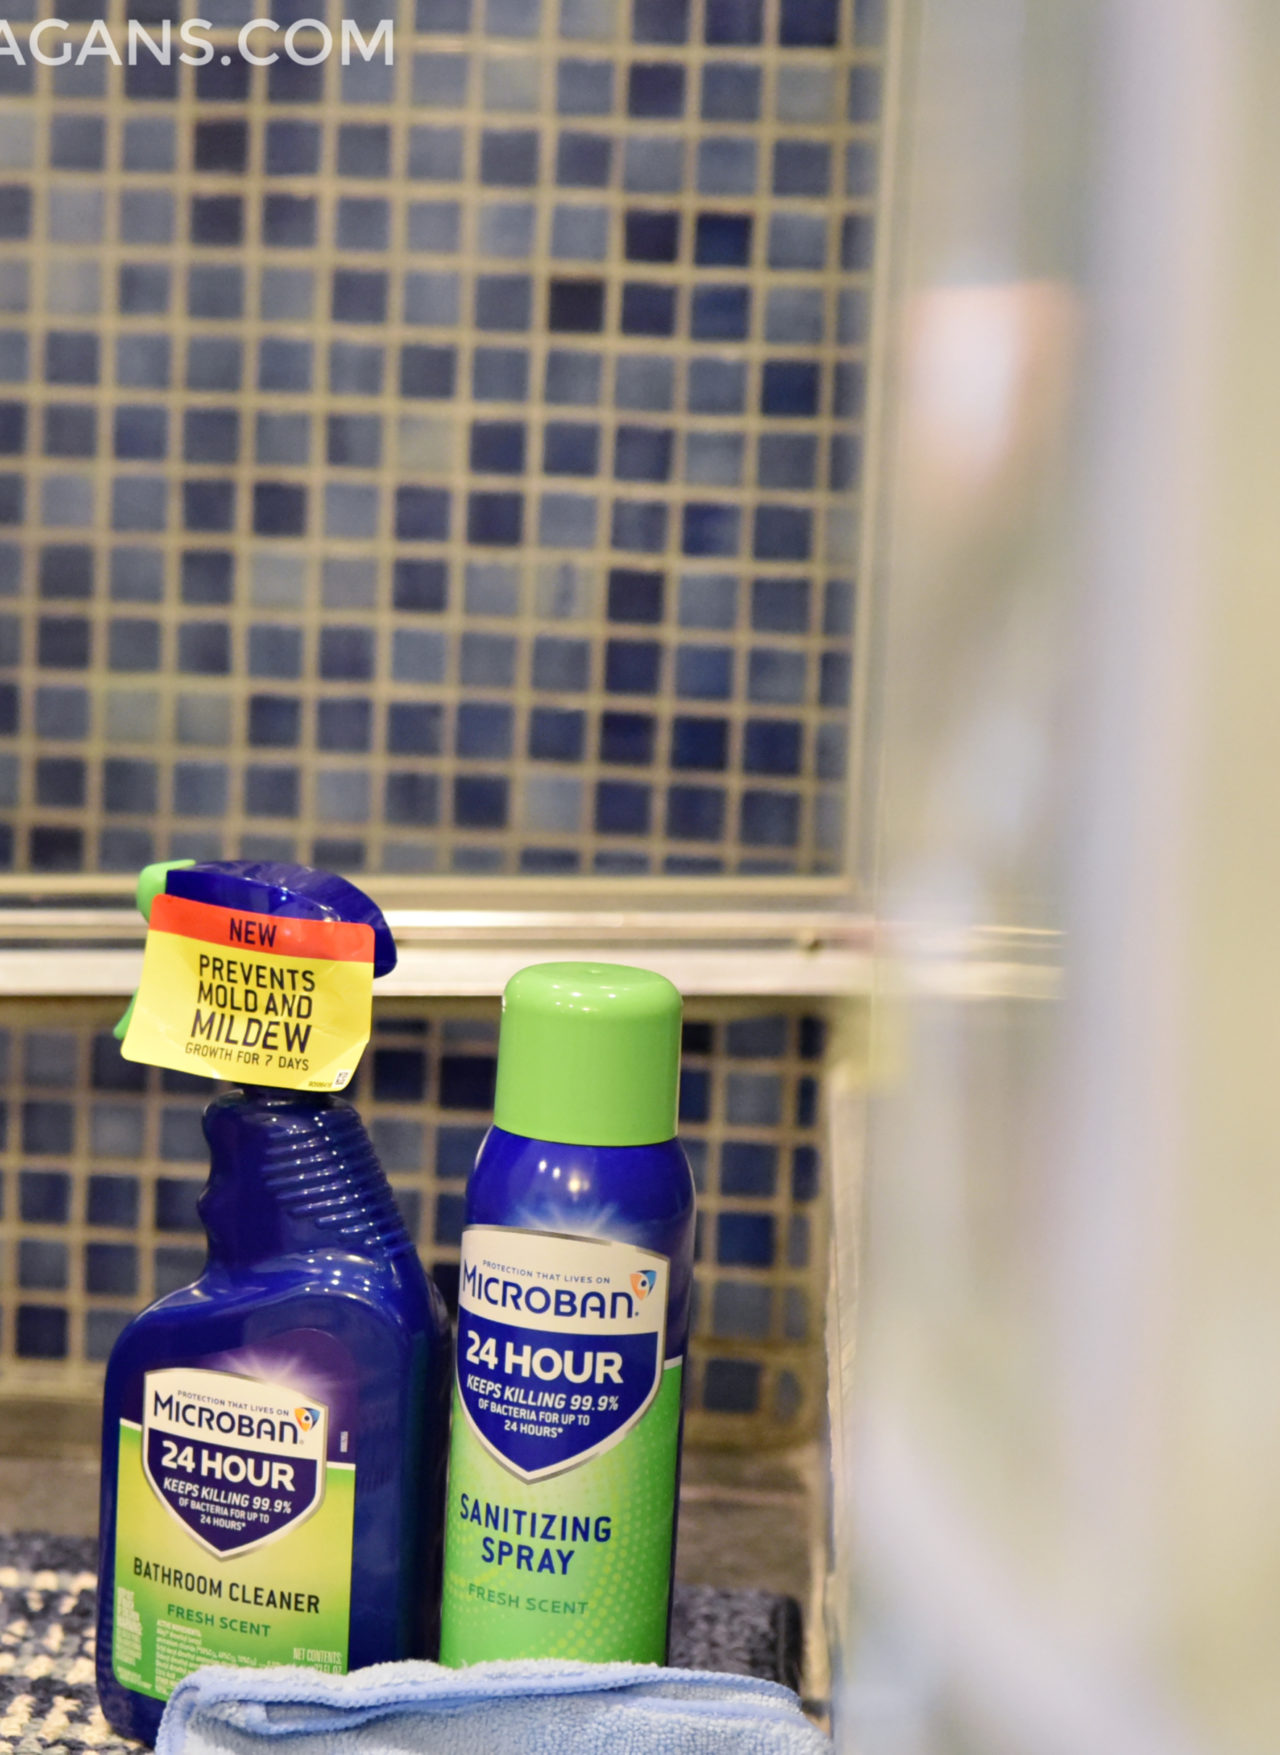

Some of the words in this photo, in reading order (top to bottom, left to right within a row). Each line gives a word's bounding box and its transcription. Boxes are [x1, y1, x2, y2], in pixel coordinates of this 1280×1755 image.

[229, 918, 277, 948] NEW
[199, 954, 316, 992] PREVENTS
[197, 980, 258, 1013] MOLD
[265, 994, 313, 1019] AND
[191, 1008, 312, 1053] MILDEW
[185, 1042, 233, 1061] GROWTH
[237, 1050, 260, 1065] FOR
[265, 1054, 273, 1066] 7
[278, 1056, 309, 1071] DAYS
[482, 1259, 533, 1278] PROTECTION
[537, 1271, 561, 1281] THAT
[564, 1274, 593, 1284] LIVES
[596, 1276, 611, 1284] ON
[466, 1329, 498, 1370] 24
[504, 1341, 624, 1384] HOUR
[177, 1390, 225, 1406] PROTECTION
[228, 1401, 248, 1410] THAT
[250, 1404, 274, 1414] LIVES
[276, 1409, 289, 1417] ON
[466, 1374, 502, 1399] KEEPS
[504, 1386, 567, 1409] KILLING
[570, 1395, 619, 1411] 99.9%
[478, 1398, 489, 1410] OF
[490, 1402, 537, 1421] BACTERIA
[539, 1411, 559, 1424] FOR
[561, 1413, 576, 1425] UP
[578, 1415, 590, 1426] TO
[504, 1420, 517, 1432] 24
[161, 1440, 196, 1474] 24
[201, 1456, 296, 1492] HOUR
[163, 1477, 199, 1497] KEEPS
[201, 1486, 250, 1508] KILLING
[252, 1496, 292, 1514] 99.9%
[179, 1497, 189, 1507] OF
[190, 1499, 229, 1516] BACTERIA
[230, 1508, 245, 1519] FOR
[247, 1511, 258, 1521] UP
[259, 1513, 269, 1524] TO
[200, 1514, 211, 1524] 24
[460, 1493, 612, 1543] SANITIZING
[481, 1537, 575, 1575] SPRAY
[134, 1557, 222, 1598] BATHROOM
[229, 1582, 320, 1614] CLEANER
[468, 1583, 519, 1608] FRESH
[526, 1597, 589, 1615] SCENT
[167, 1603, 215, 1627] FRESH
[220, 1616, 271, 1637] SCENT
